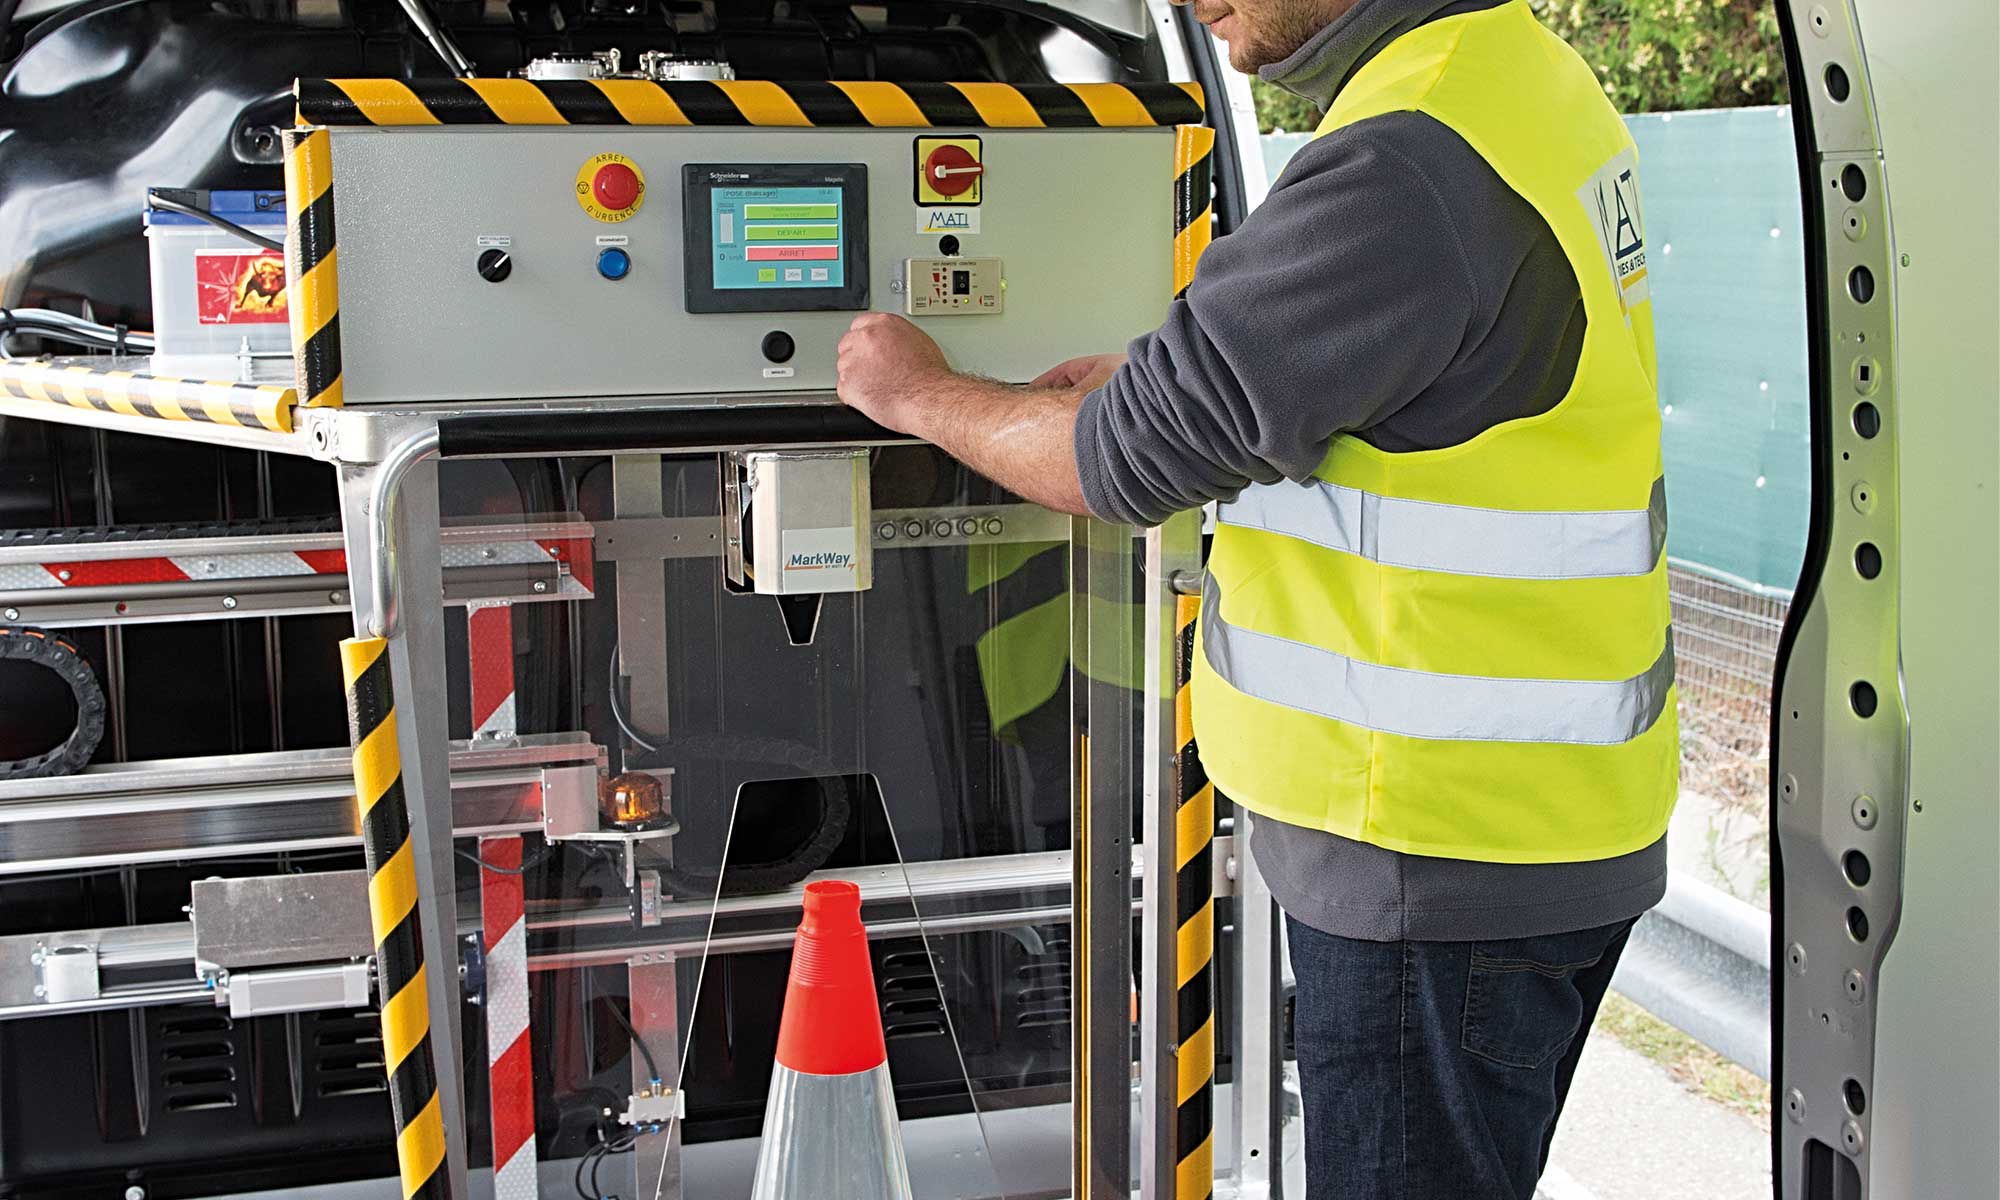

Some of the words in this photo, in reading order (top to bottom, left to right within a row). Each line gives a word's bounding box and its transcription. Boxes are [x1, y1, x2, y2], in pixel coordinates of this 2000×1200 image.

[595, 153, 625, 164] ARRET
[709, 172, 740, 183] Schneider
[586, 204, 637, 222] D'URGENCE
[928, 211, 969, 229] MATI
[776, 229, 807, 237] DEPART
[778, 249, 806, 257] ARRET
[791, 552, 851, 568] MarkWay
